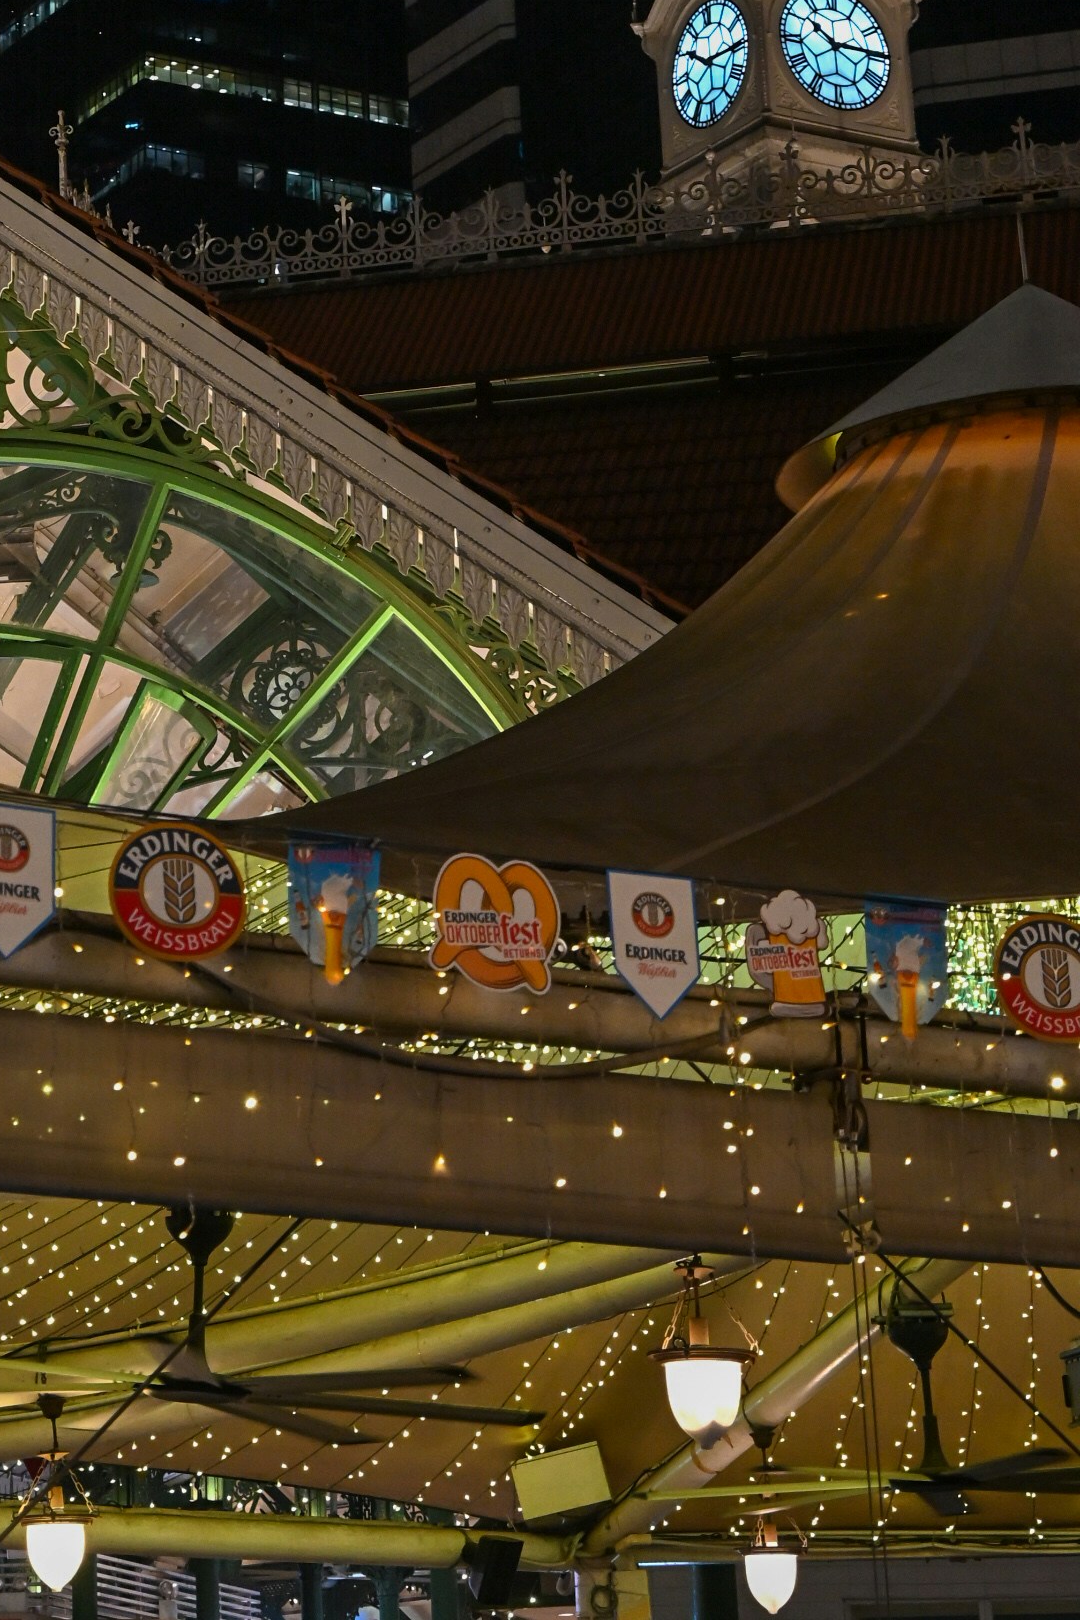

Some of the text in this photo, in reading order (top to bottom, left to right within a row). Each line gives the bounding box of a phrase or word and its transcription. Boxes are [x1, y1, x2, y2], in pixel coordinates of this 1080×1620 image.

[119, 832, 234, 886] ERDINGER
[444, 910, 499, 924] ERDINGER
[446, 913, 541, 945] OKTOBERfest
[625, 943, 688, 966] ERDINGER
[751, 947, 815, 972] OKTOBERfest
[1002, 923, 1080, 968] ERDING
